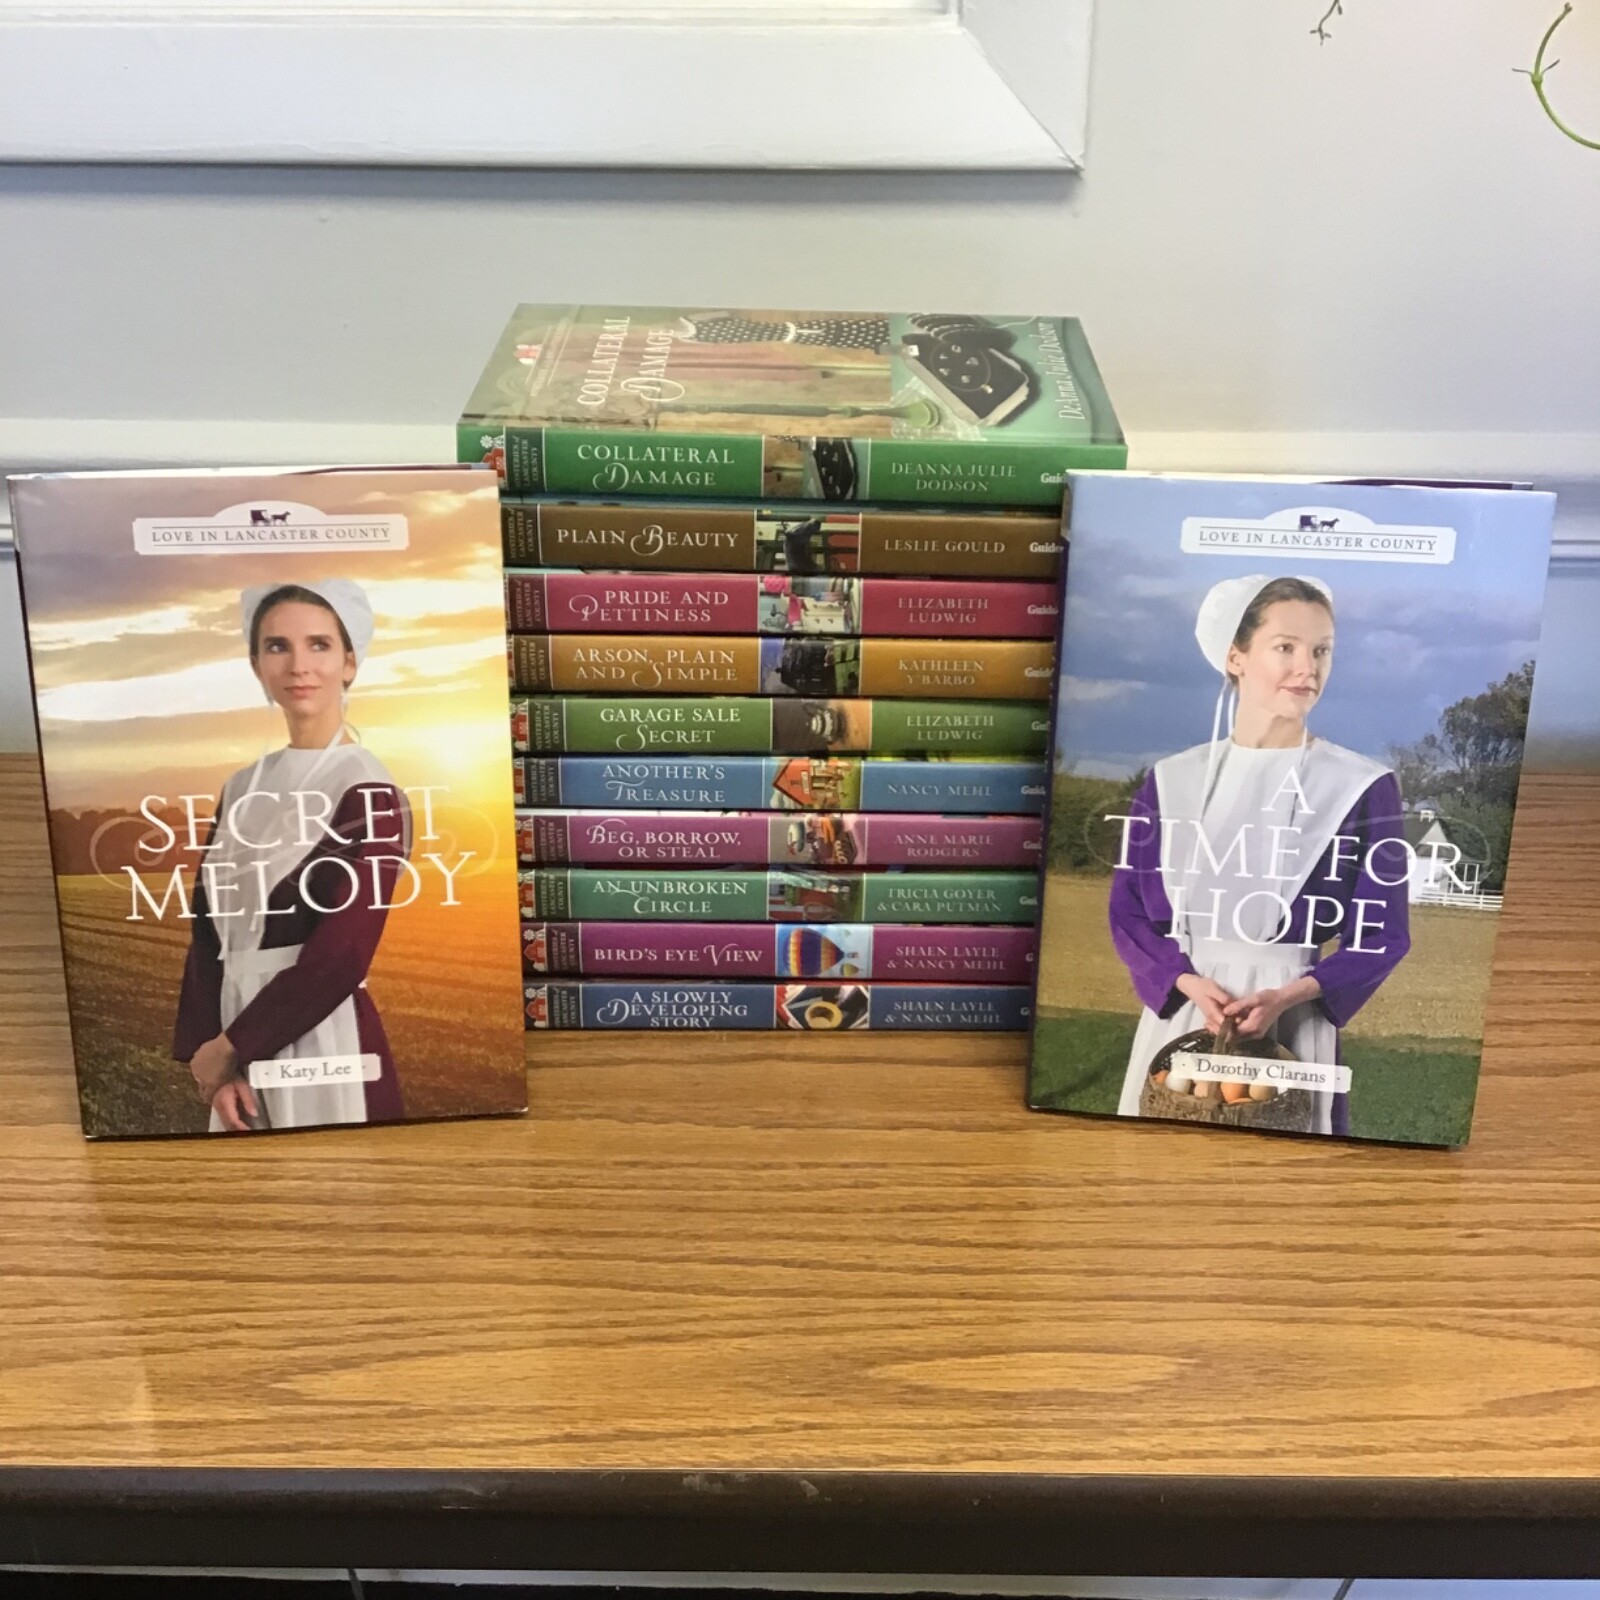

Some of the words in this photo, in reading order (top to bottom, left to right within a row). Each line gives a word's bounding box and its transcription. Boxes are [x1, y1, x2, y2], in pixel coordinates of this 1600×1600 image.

[577, 316, 630, 405] COLLATERAL
[621, 329, 685, 402] DAMAGE
[577, 445, 735, 464] COLLATERAL
[593, 463, 716, 491] DAMAGE
[891, 462, 966, 477] DEANNA
[968, 464, 1017, 478] JULIE
[916, 479, 989, 493] DODSON
[152, 530, 193, 542] LOVE
[201, 530, 218, 541] IN
[225, 528, 319, 541] LANCASTER
[325, 527, 390, 539] COUNTY
[557, 529, 626, 544] PLAIN
[630, 524, 739, 556] BEAUTY
[1199, 531, 1240, 543] LOVE
[1246, 532, 1263, 543] IN
[1271, 534, 1363, 547] LANCASTER
[1370, 538, 1437, 551] COUNTY
[884, 540, 939, 551] LESLIE
[945, 541, 1005, 553] GOULD
[605, 591, 671, 605] PRIDE
[680, 591, 729, 605] AND
[898, 598, 989, 609] ELIZABETH
[569, 594, 711, 622] PETTINESS
[909, 612, 976, 624] LUDWIG
[573, 648, 654, 664] ARSON,
[667, 649, 735, 664] PLAIN
[899, 660, 984, 671] KATHLEEN
[576, 667, 626, 680] AND
[632, 662, 737, 690] SIMPLE
[600, 708, 685, 722] GARAGE
[692, 708, 741, 722] SALE
[906, 715, 994, 727] ELIZABETH
[616, 723, 715, 751] SECRET
[918, 730, 983, 741] LUDWIG
[602, 764, 726, 780] ANOTHER'S
[605, 780, 725, 802] TREASURE
[887, 784, 940, 795] NANCY
[948, 785, 993, 796] MEHL
[1261, 766, 1316, 815] A
[138, 785, 450, 853] SECRET
[587, 818, 639, 845] BEG,
[645, 831, 741, 846] BORROW,
[896, 834, 939, 845] ANNE
[944, 835, 993, 845] MARIE
[618, 847, 650, 858] OR
[657, 847, 721, 858] STEAL
[907, 847, 980, 857] RODGERS
[1104, 814, 1302, 881] TIME
[1323, 835, 1472, 891] FOR
[121, 851, 477, 921] MELODY
[593, 881, 620, 894] AN
[631, 881, 748, 895] UNBROKEN
[889, 888, 939, 899] TRICIA
[943, 889, 996, 900] GOYER
[877, 903, 887, 911] &
[892, 902, 931, 912] CARA
[936, 902, 1002, 912] PUTMAN
[1164, 886, 1388, 954] HOPE
[594, 947, 657, 961] BIRD'S
[666, 950, 699, 961] EYE
[703, 943, 763, 966] VIEW
[896, 946, 947, 957] SHAEN
[954, 946, 999, 957] LAYLE
[887, 961, 897, 969] &
[901, 960, 955, 970] NANCY
[963, 960, 1005, 970] MEHL
[631, 991, 643, 1004] A
[651, 991, 732, 1004] SLOWLY
[597, 998, 748, 1024] DEVELOPING
[894, 1001, 944, 1012] SHAEN
[951, 1002, 995, 1012] LAYLE
[650, 1017, 715, 1028] STORY
[885, 1014, 894, 1023] &
[901, 1013, 953, 1023] NANCY
[961, 1014, 1001, 1023] MEHL
[280, 1062, 318, 1080] Katy
[323, 1061, 352, 1077] Lee
[1197, 1057, 1261, 1079] Dorothy
[1266, 1064, 1326, 1084] Clarans
